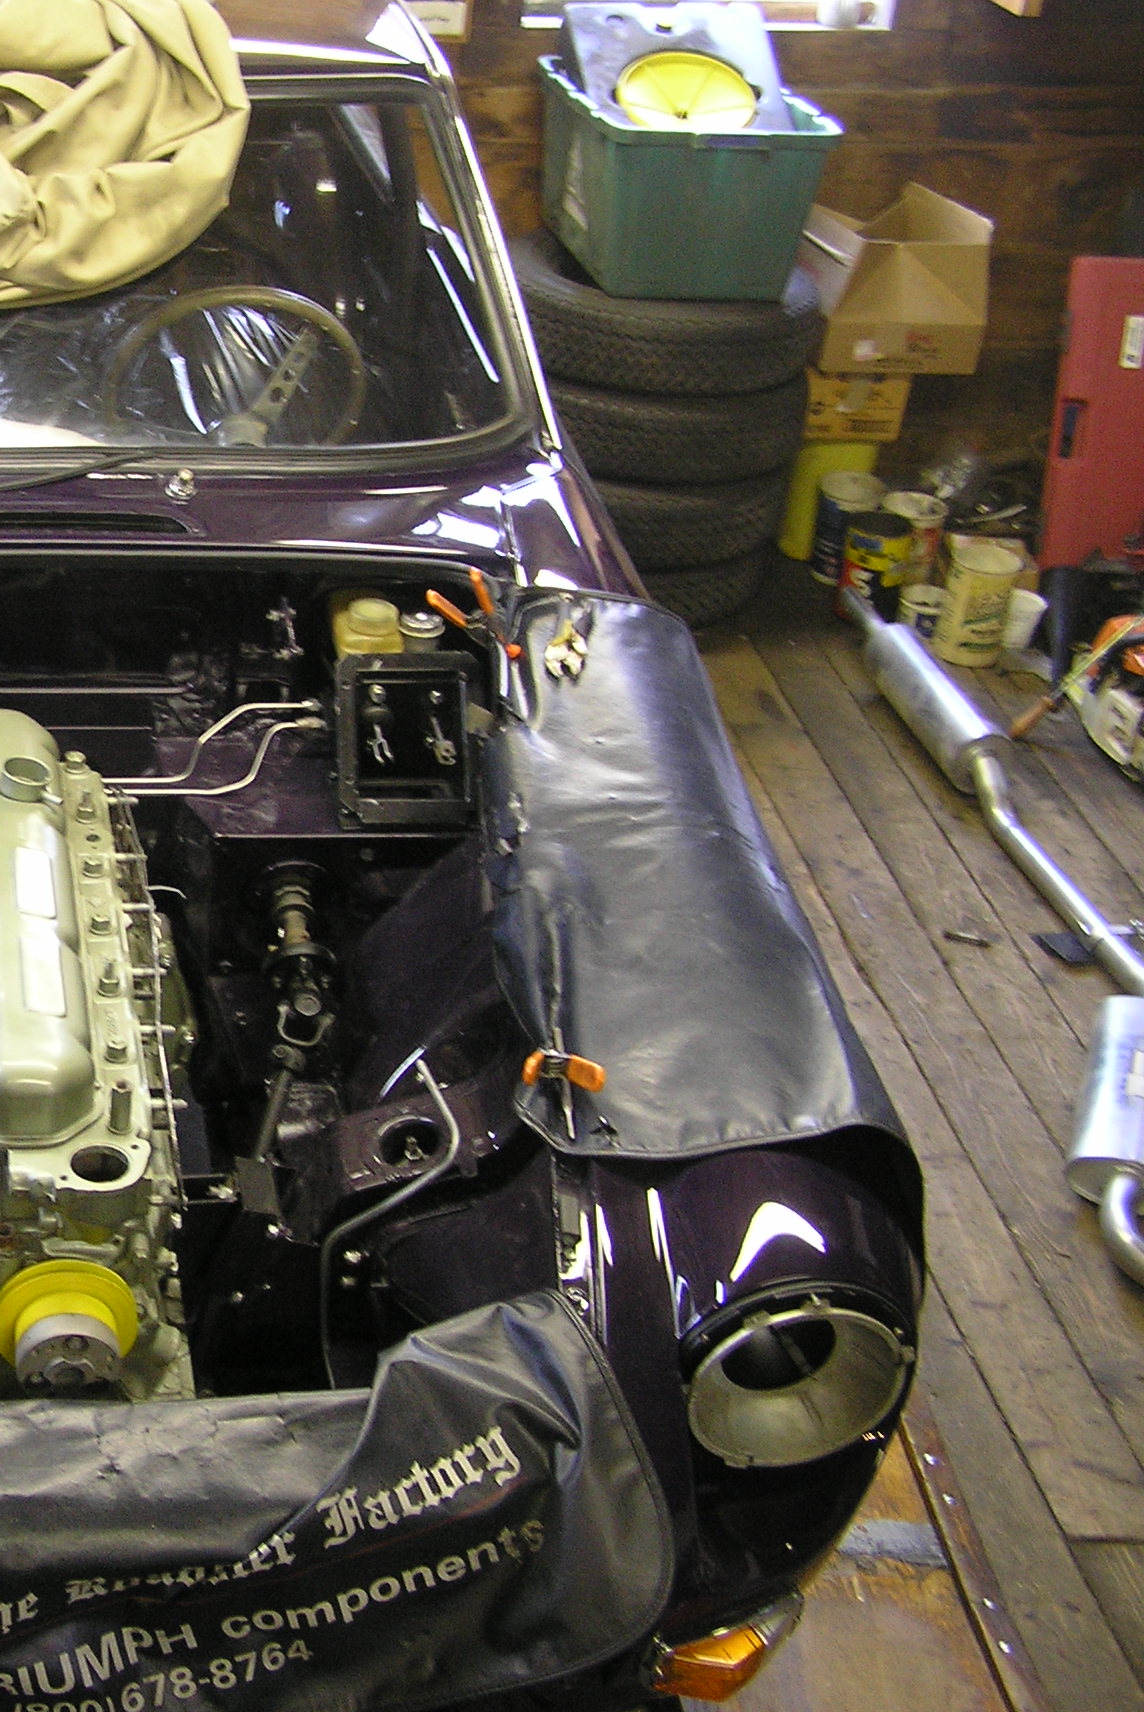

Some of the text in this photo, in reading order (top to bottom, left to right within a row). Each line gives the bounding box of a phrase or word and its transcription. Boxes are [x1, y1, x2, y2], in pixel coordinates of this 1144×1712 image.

[316, 1424, 521, 1549] Factory
[221, 1519, 545, 1640] components
[14, 1639, 313, 1712] 678-8764
